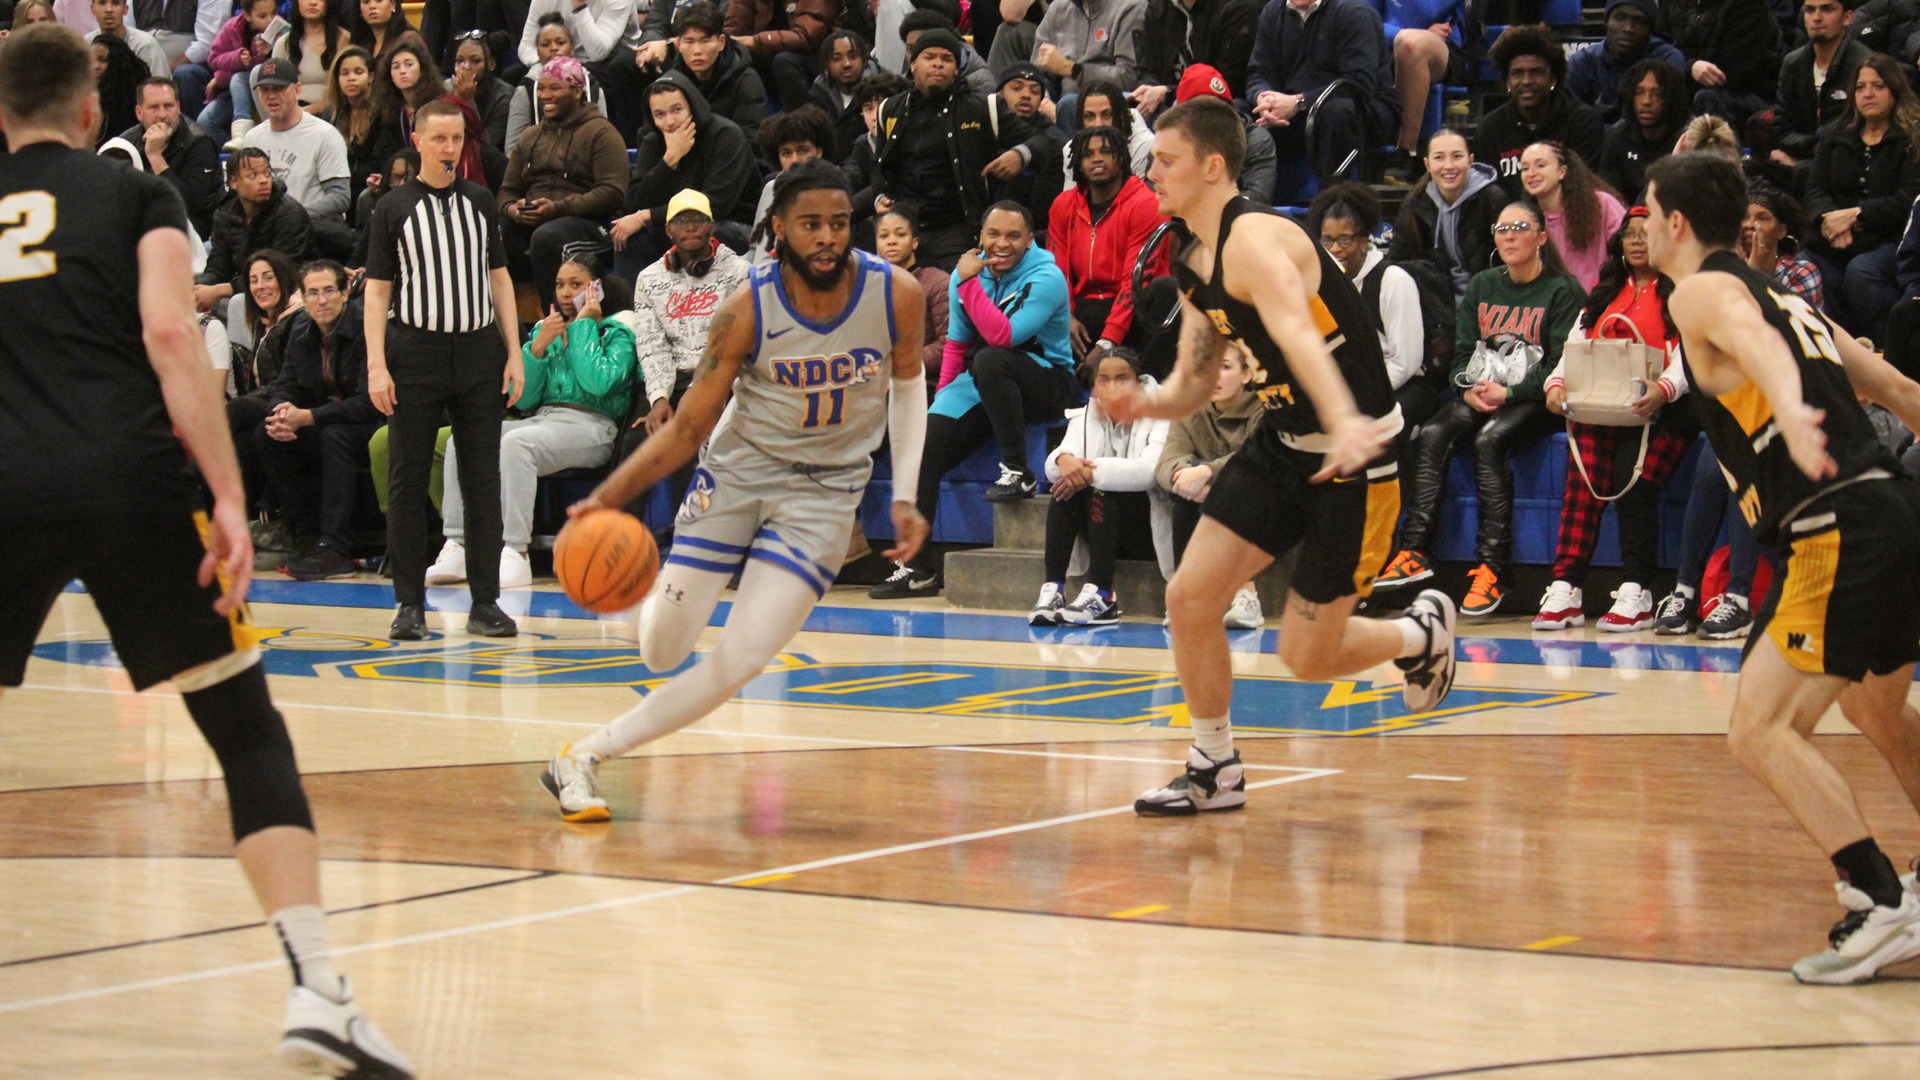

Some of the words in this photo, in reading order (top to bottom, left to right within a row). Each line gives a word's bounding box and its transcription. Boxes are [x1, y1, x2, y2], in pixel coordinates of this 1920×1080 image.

[0, 189, 57, 283] 2
[1479, 303, 1545, 347] MIAMI
[769, 352, 857, 387] NDC
[801, 387, 846, 429] 11
